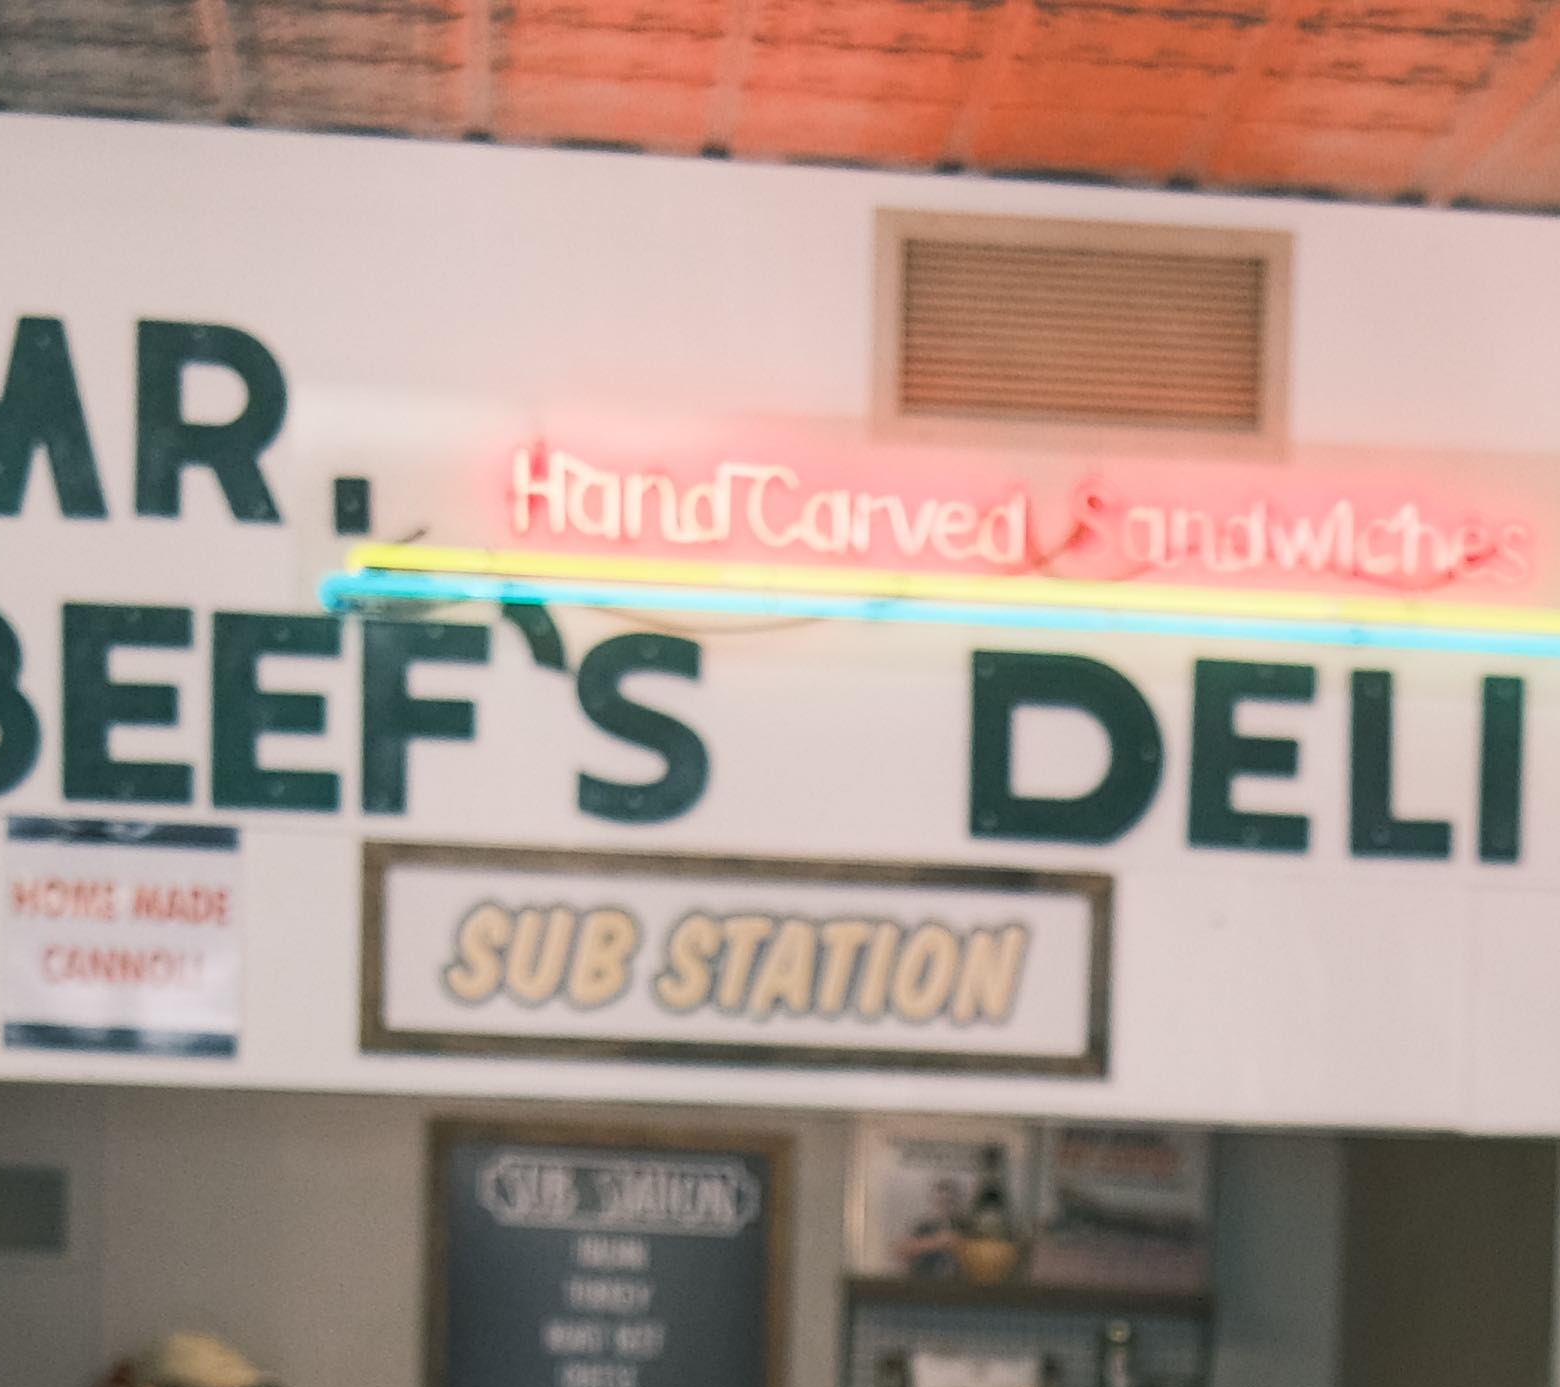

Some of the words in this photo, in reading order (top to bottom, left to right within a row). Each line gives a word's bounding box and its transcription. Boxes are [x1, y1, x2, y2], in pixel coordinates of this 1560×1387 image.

[513, 449, 740, 543] Hand
[743, 466, 1029, 564] Carved
[1077, 484, 1532, 585] Sandwiches
[970, 648, 1524, 862] DELI
[132, 885, 231, 927] MADE
[445, 900, 638, 1008] SUB
[658, 909, 1030, 1029] STATION
